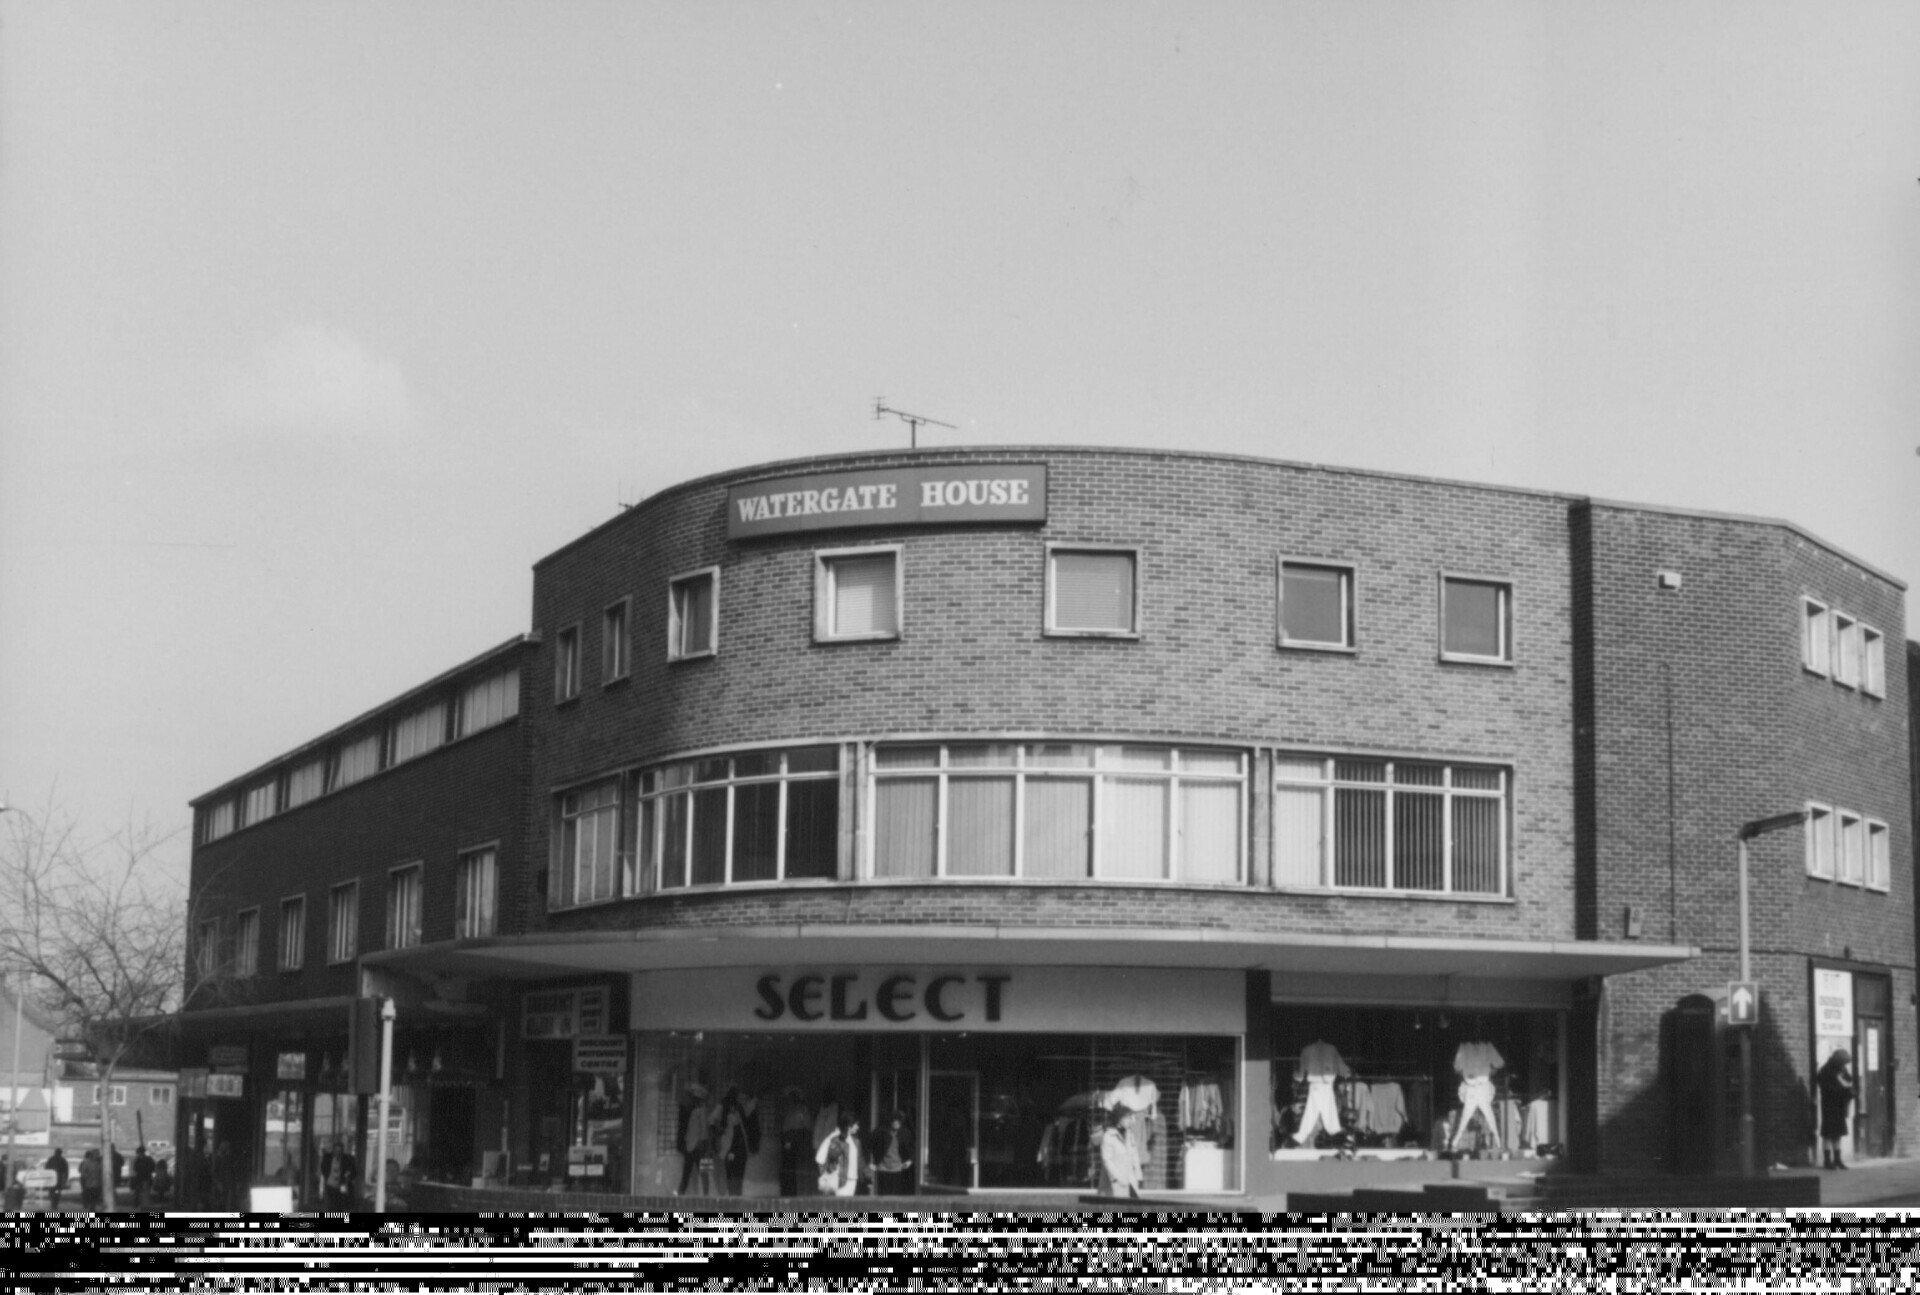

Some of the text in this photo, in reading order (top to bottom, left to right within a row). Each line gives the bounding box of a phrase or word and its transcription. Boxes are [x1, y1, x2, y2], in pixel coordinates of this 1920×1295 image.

[737, 479, 1029, 522] WATERGATE HOUSE
[754, 974, 1012, 1022] SELECT
[580, 1060, 619, 1068] CENTRE
